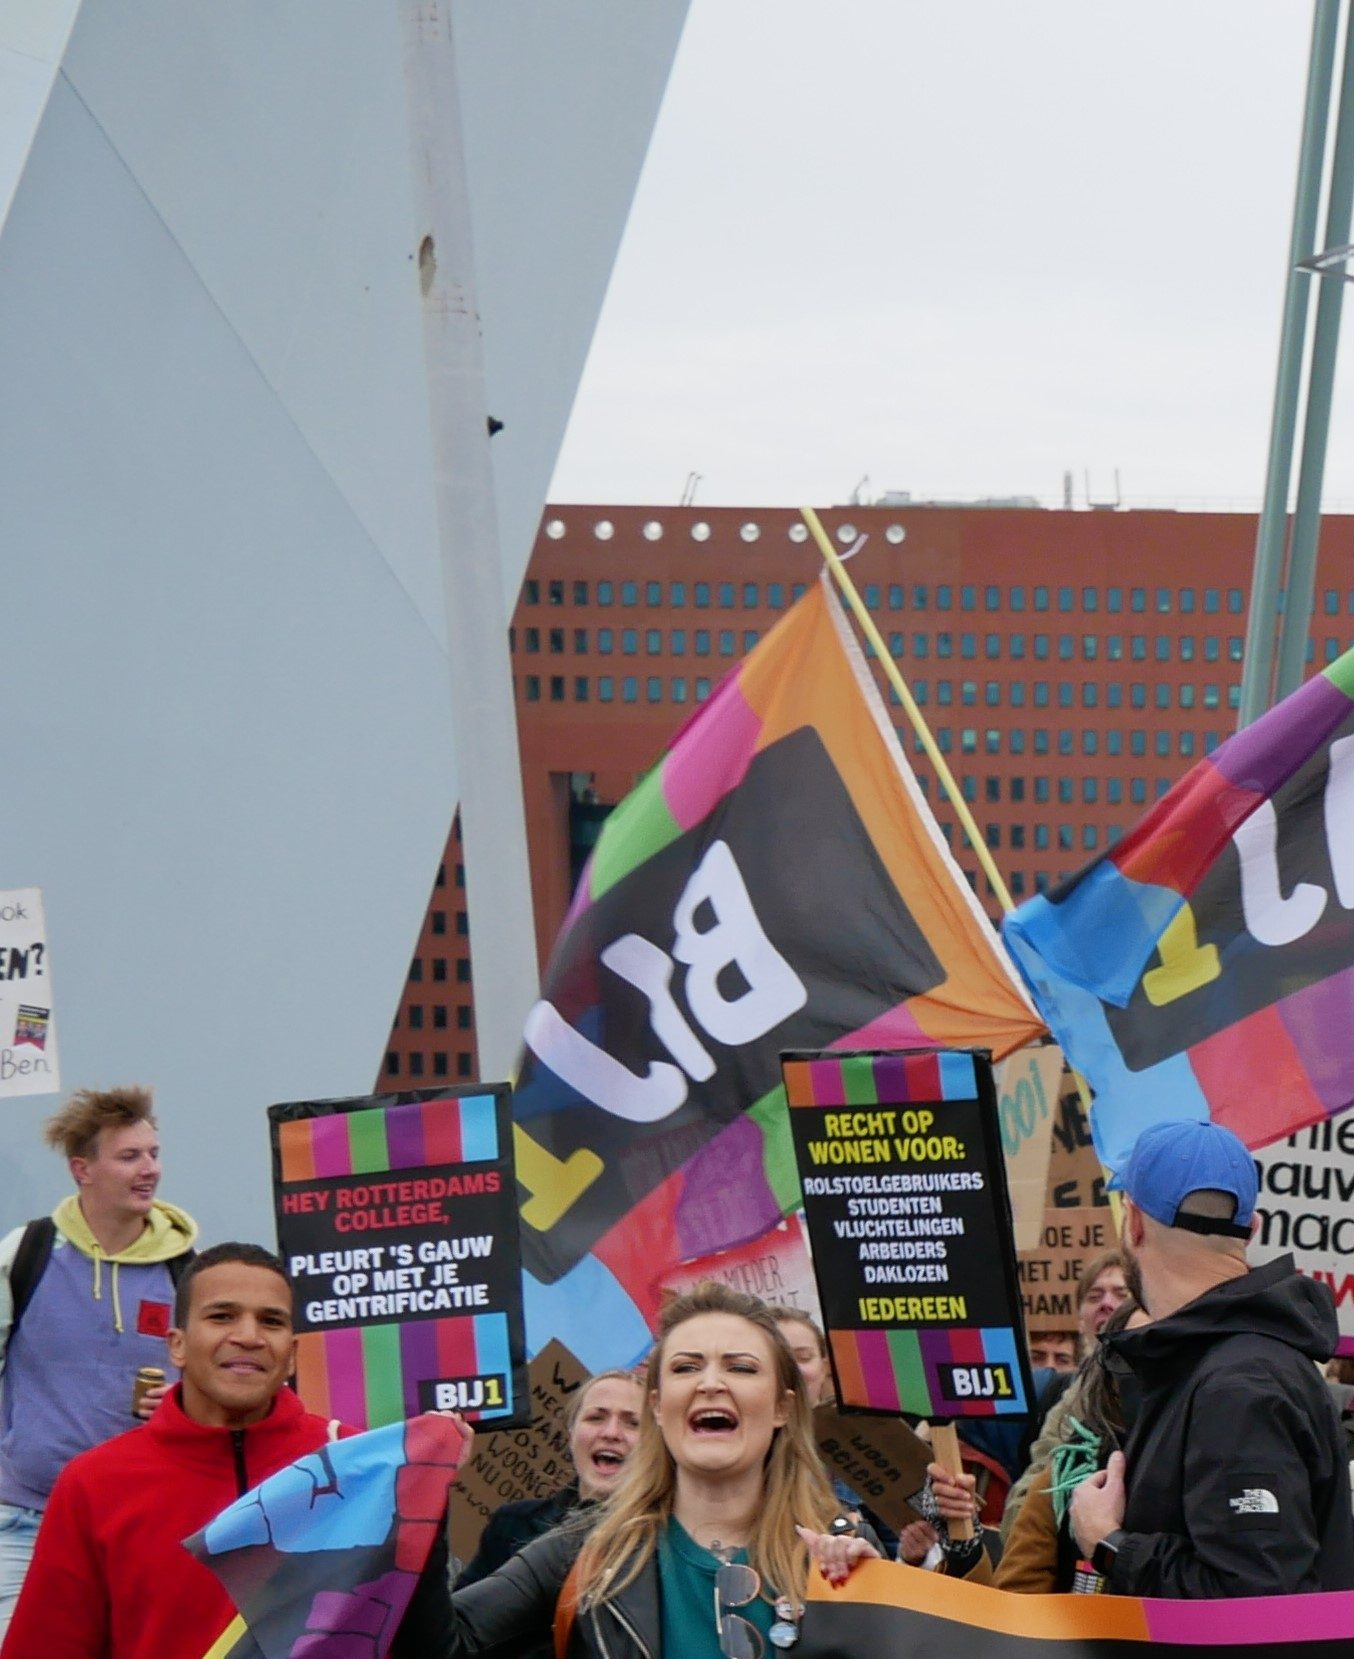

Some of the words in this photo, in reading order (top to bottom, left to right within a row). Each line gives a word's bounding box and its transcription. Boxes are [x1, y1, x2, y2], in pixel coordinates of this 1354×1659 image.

[824, 1111, 896, 1137] RECHT
[902, 1110, 934, 1133] OP
[808, 1139, 891, 1165] WONEN
[893, 1136, 966, 1162] VOOR:
[283, 1191, 329, 1214] HEY
[336, 1172, 501, 1209] ROTTERDAMS
[804, 1172, 984, 1195] ROLSTOELGEBRUIKERS
[335, 1202, 451, 1232] COLLEGE,
[848, 1197, 942, 1216] STUDENTEN
[833, 1218, 965, 1238] VLUCHTELINGEN
[1040, 1226, 1072, 1248] OE
[1079, 1225, 1104, 1247] JE
[290, 1247, 385, 1277] PLEURT
[390, 1245, 414, 1266] 'S
[418, 1236, 494, 1263] GAUW
[859, 1241, 947, 1260] ARBEIDERS
[333, 1273, 368, 1296] OP
[373, 1267, 425, 1292] MET
[430, 1263, 459, 1286] JE
[864, 1265, 949, 1283] DAKLOZEN
[1059, 1259, 1083, 1281] JE
[306, 1284, 489, 1323] GENTRIFICATIE
[858, 1296, 967, 1321] IEDEREEN
[435, 1379, 503, 1410] BIJ1
[952, 1368, 1011, 1396] BIJ1
